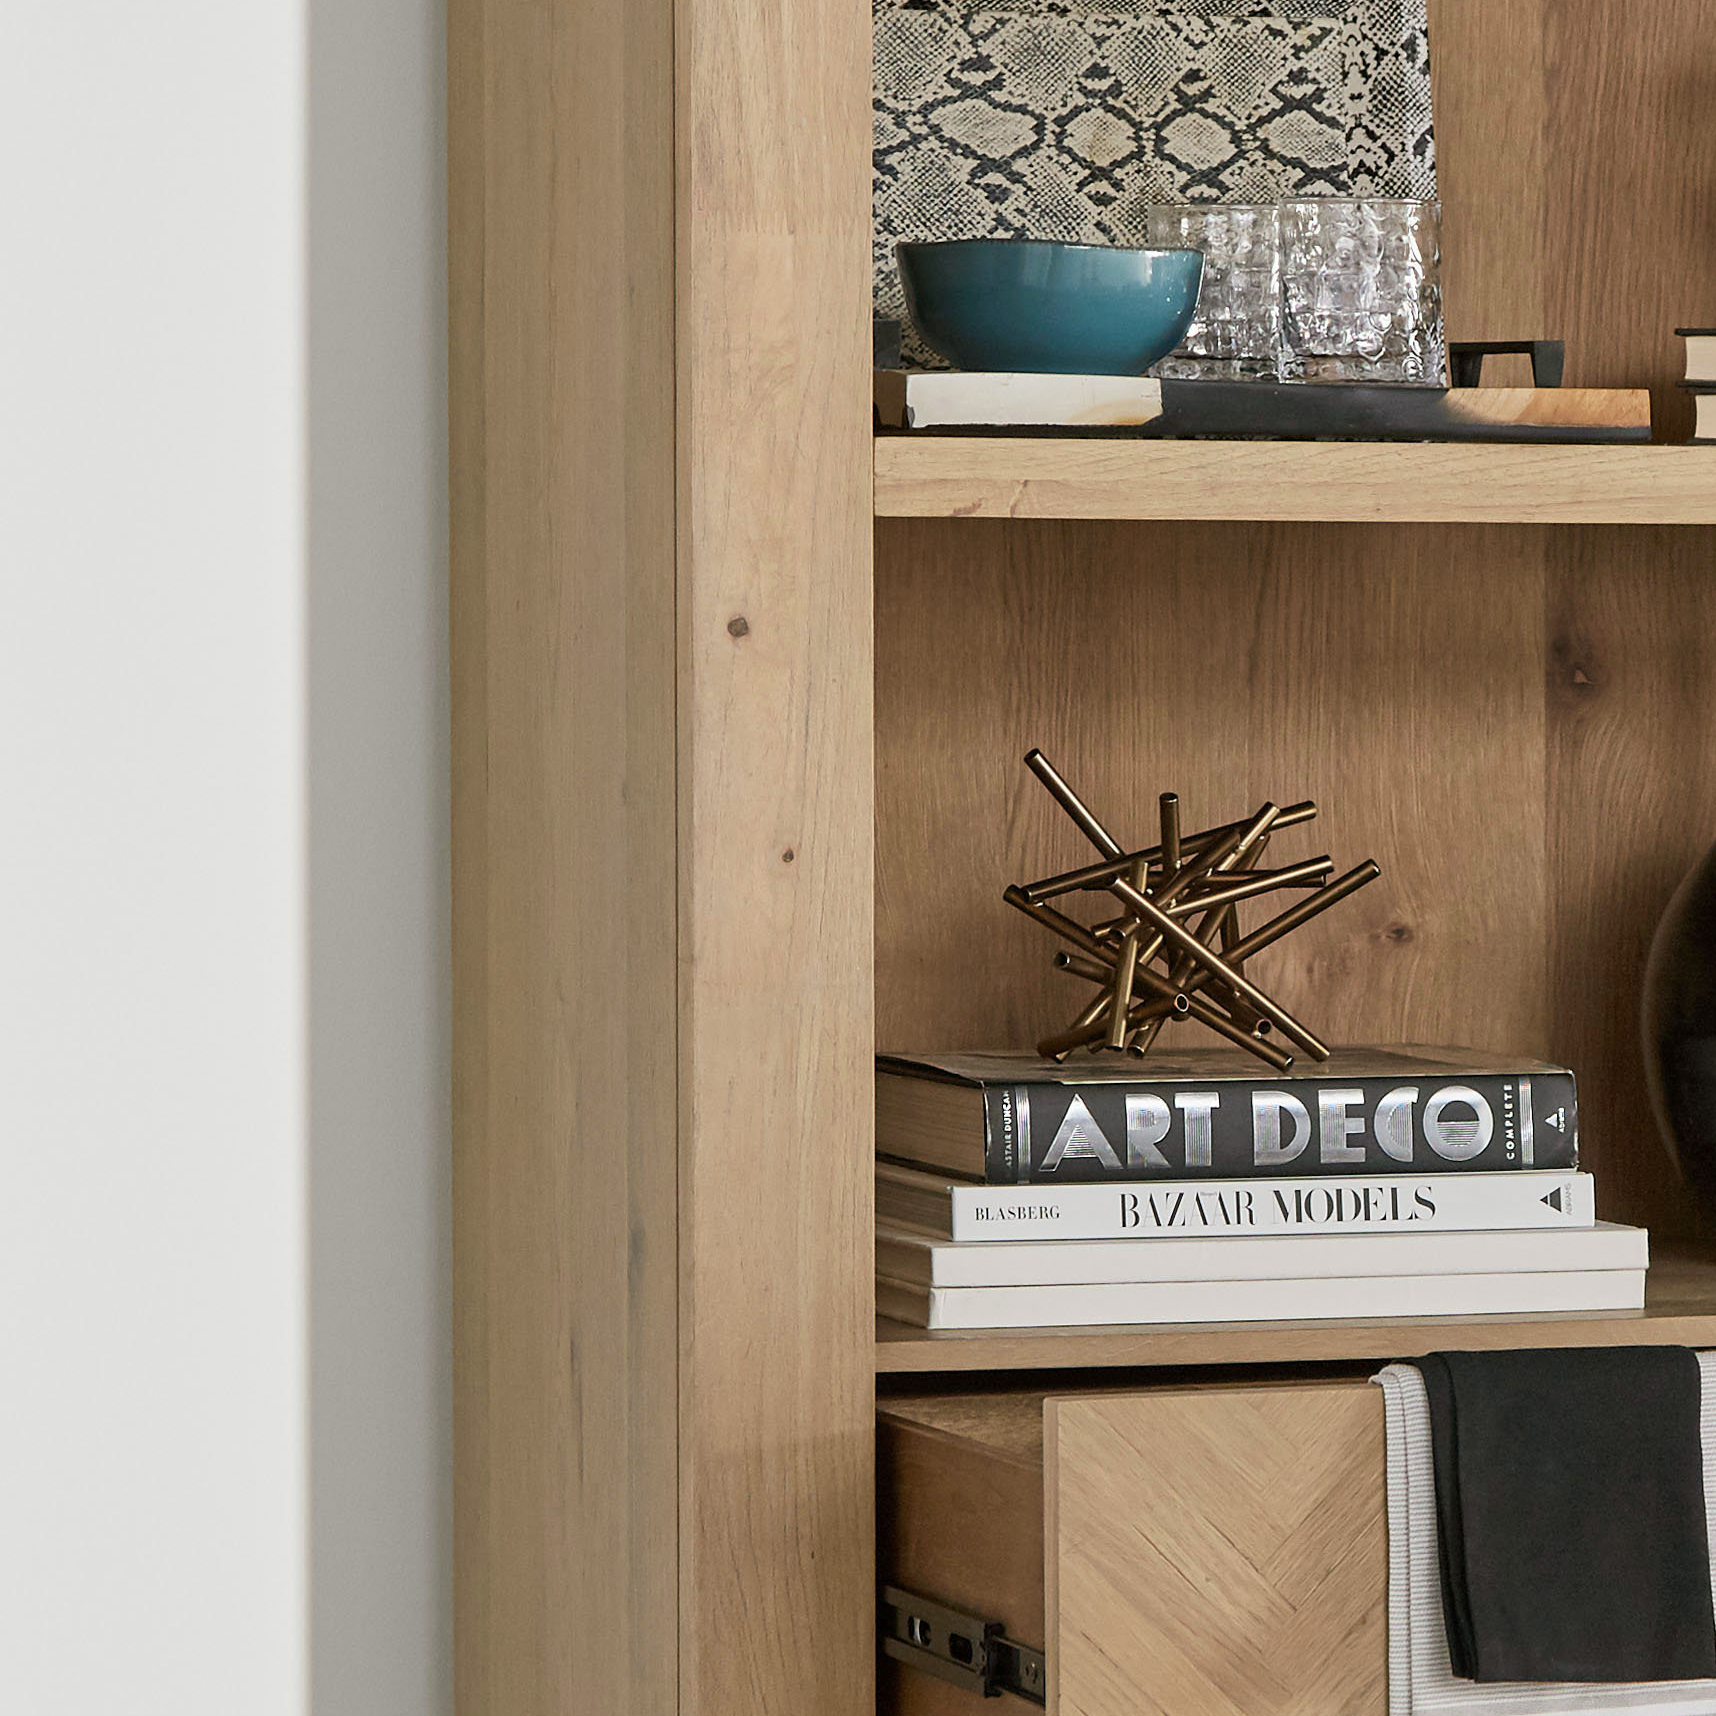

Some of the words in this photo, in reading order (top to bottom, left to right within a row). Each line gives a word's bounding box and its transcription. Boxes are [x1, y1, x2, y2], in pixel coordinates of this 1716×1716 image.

[1038, 1091, 1221, 1172] ART
[1251, 1085, 1494, 1167] DECO
[1503, 1084, 1516, 1160] COMPLETE
[975, 1205, 1060, 1221] BLASBERG
[1120, 1189, 1258, 1228] BAZAAR
[1272, 1186, 1437, 1225] MODELS
